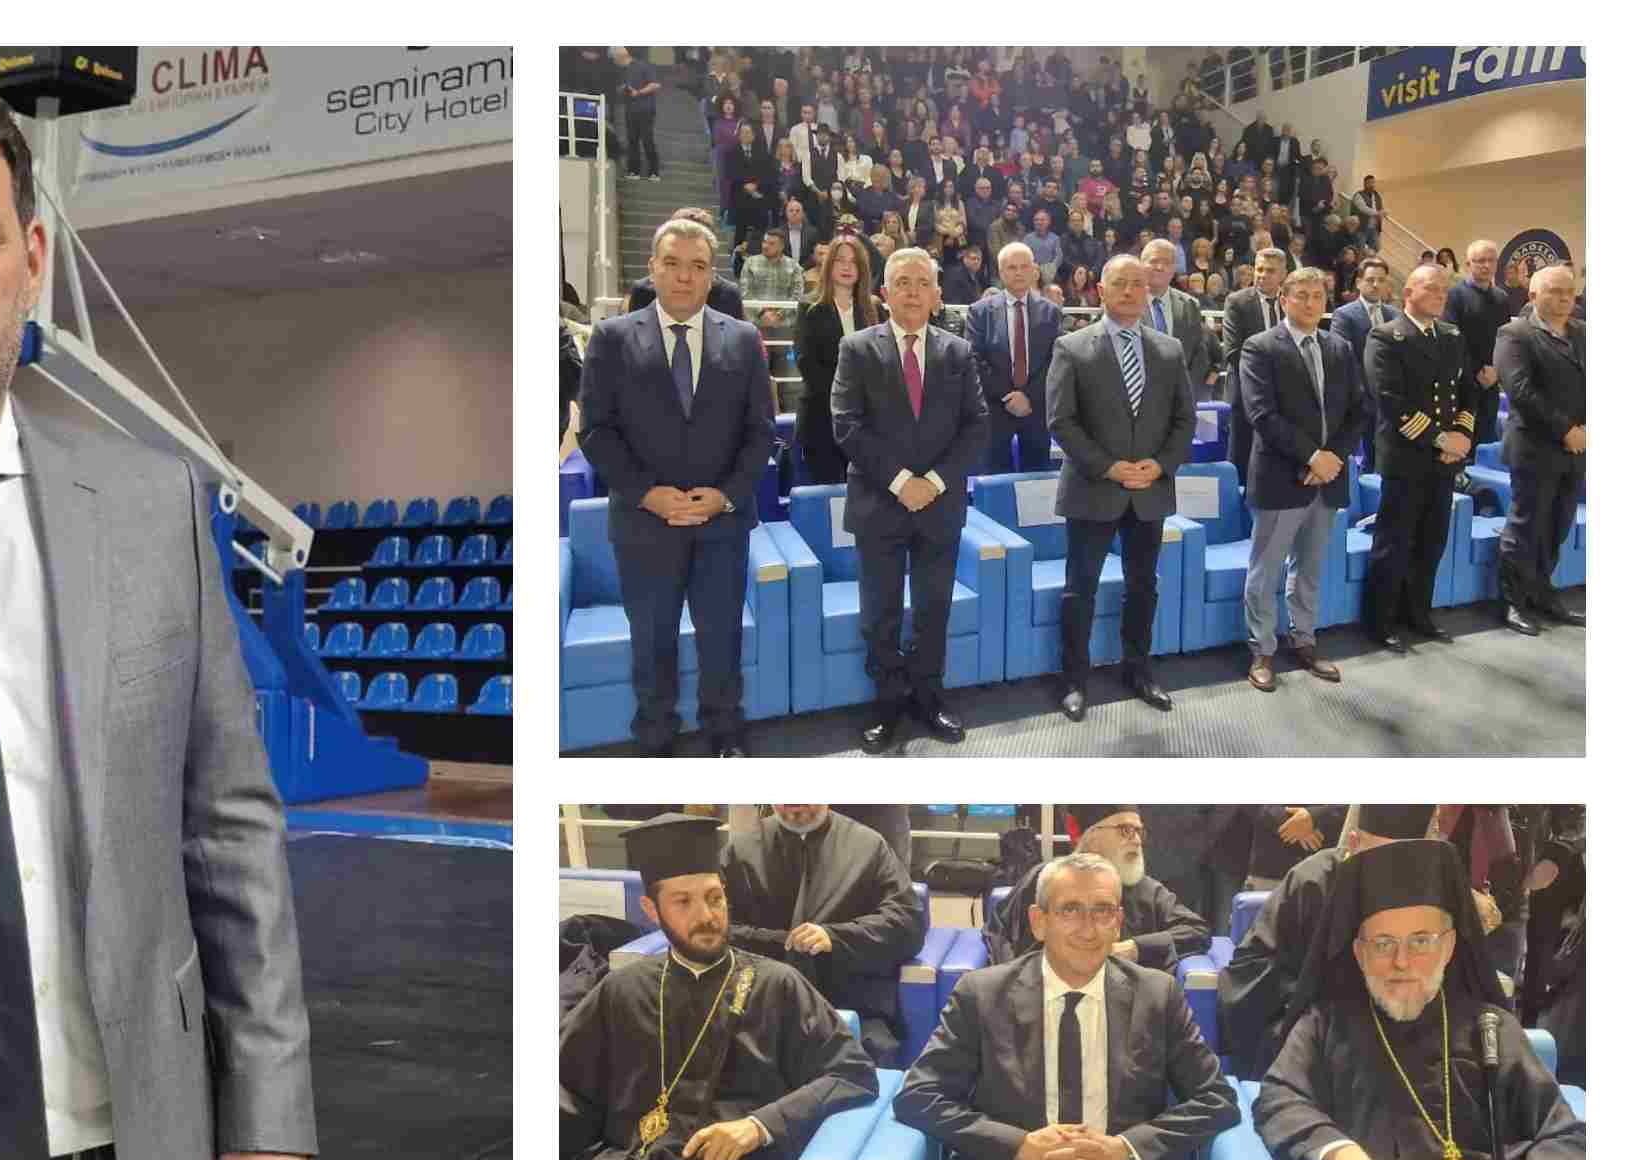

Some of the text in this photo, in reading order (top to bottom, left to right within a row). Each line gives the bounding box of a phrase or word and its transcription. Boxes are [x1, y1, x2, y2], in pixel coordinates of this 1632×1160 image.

[151, 46, 270, 95] CLIMA
[1381, 65, 1441, 110] visit
[355, 87, 509, 136] City Hotel
